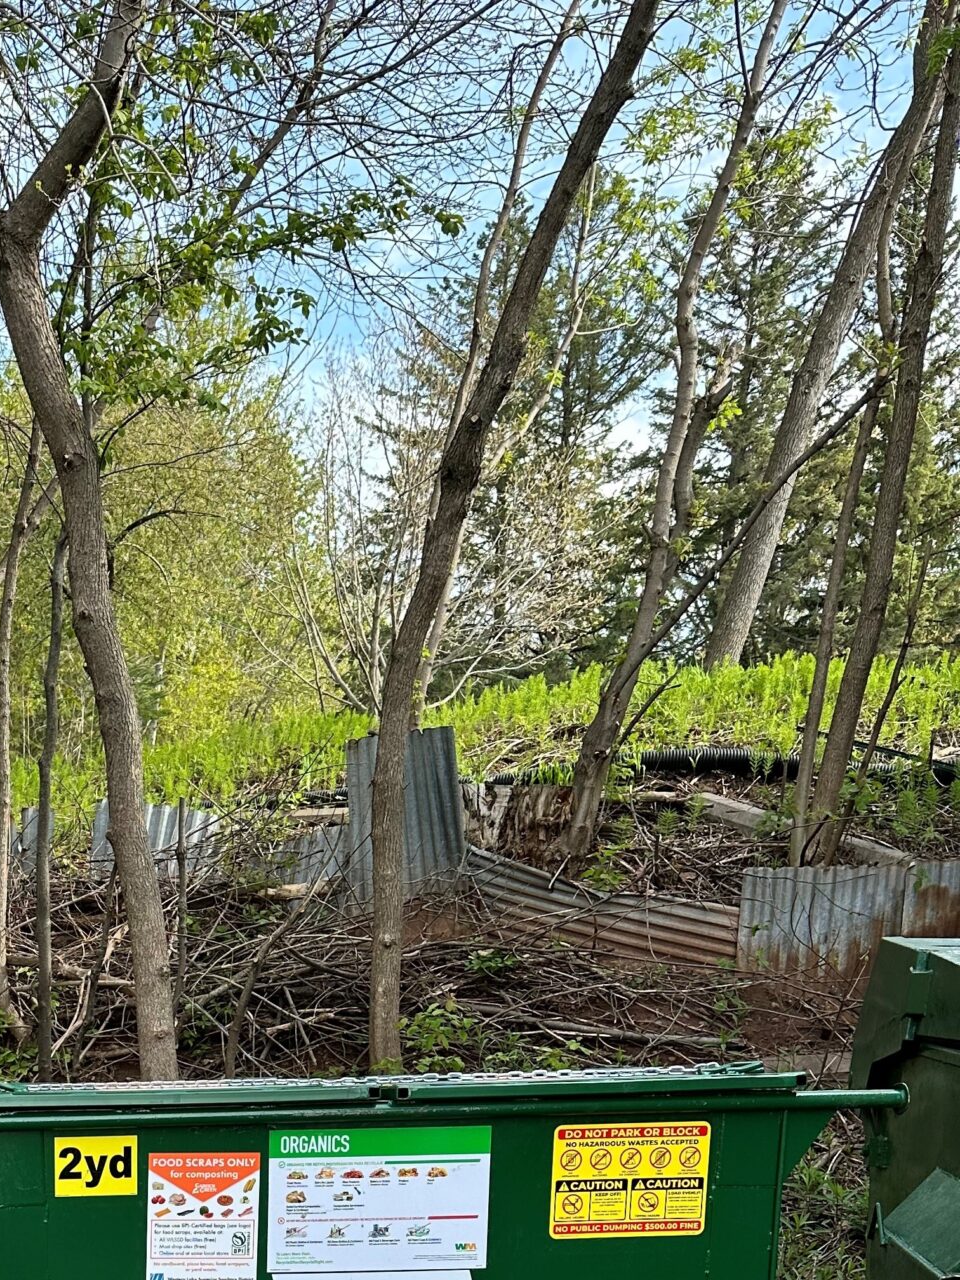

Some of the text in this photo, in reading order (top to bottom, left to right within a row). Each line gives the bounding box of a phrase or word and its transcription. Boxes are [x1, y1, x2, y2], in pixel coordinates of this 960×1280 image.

[565, 1127, 701, 1138] DO NOT PARK OR BLOCK
[280, 1135, 350, 1153] ORGANICS
[58, 1146, 132, 1188] 2yd
[152, 1158, 256, 1167] FOOD SCRAPS ONLY
[170, 1170, 239, 1180] for composting
[570, 1180, 623, 1191] CAUTION
[646, 1178, 699, 1189] CAUTION
[570, 1224, 601, 1232] PUBLIC
[602, 1223, 643, 1232] DUMPING
[644, 1222, 678, 1231] $500.00
[679, 1221, 700, 1230] FINE
